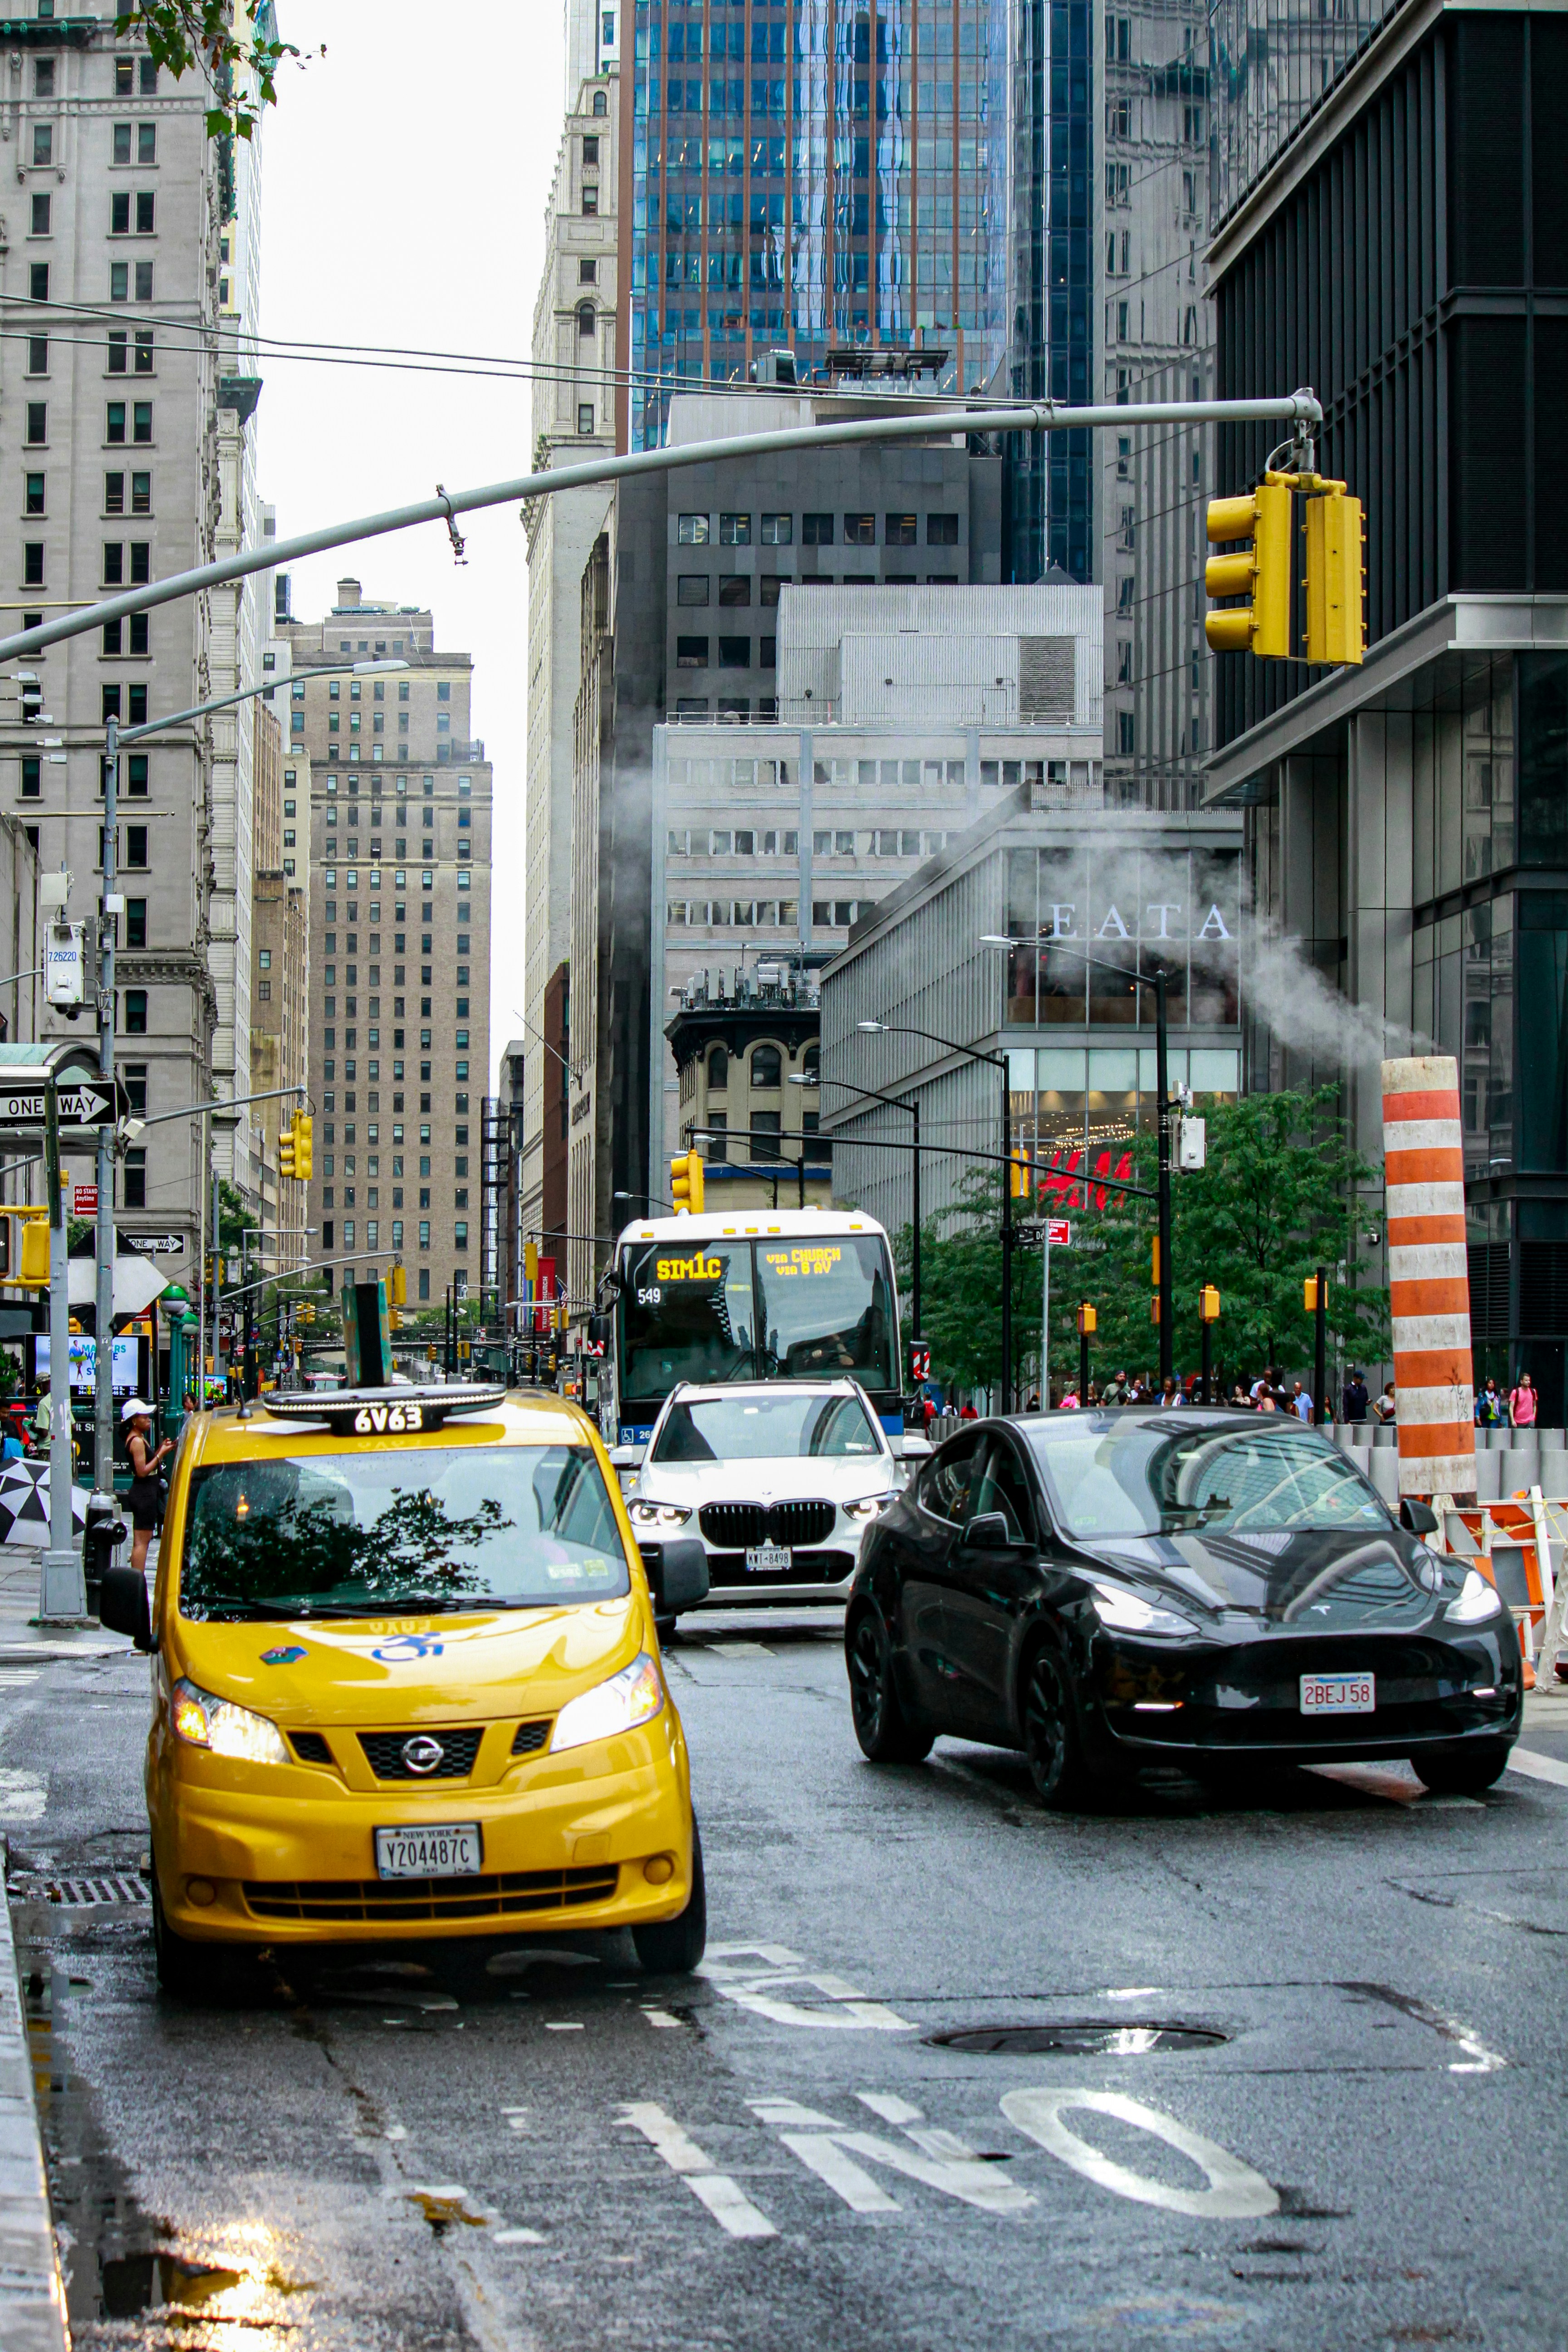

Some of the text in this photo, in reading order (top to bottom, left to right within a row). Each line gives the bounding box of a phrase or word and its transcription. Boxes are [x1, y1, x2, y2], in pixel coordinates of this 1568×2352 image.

[1049, 904, 1233, 939] EATA
[48, 951, 77, 961] 726220
[9, 1096, 97, 1115] ONE WAY
[791, 1247, 841, 1263] CHURCH
[657, 1251, 721, 1280] SIM1C
[813, 1261, 832, 1274] AV
[637, 1288, 661, 1304] 549
[82, 1344, 126, 1353] MARS
[355, 1406, 423, 1433] 6V63
[85, 1423, 95, 1431] St
[639, 1430, 652, 1439] 26
[769, 1552, 789, 1564] 8498
[403, 1829, 452, 1839] NEW YORK
[387, 1838, 469, 1867] Y204487C
